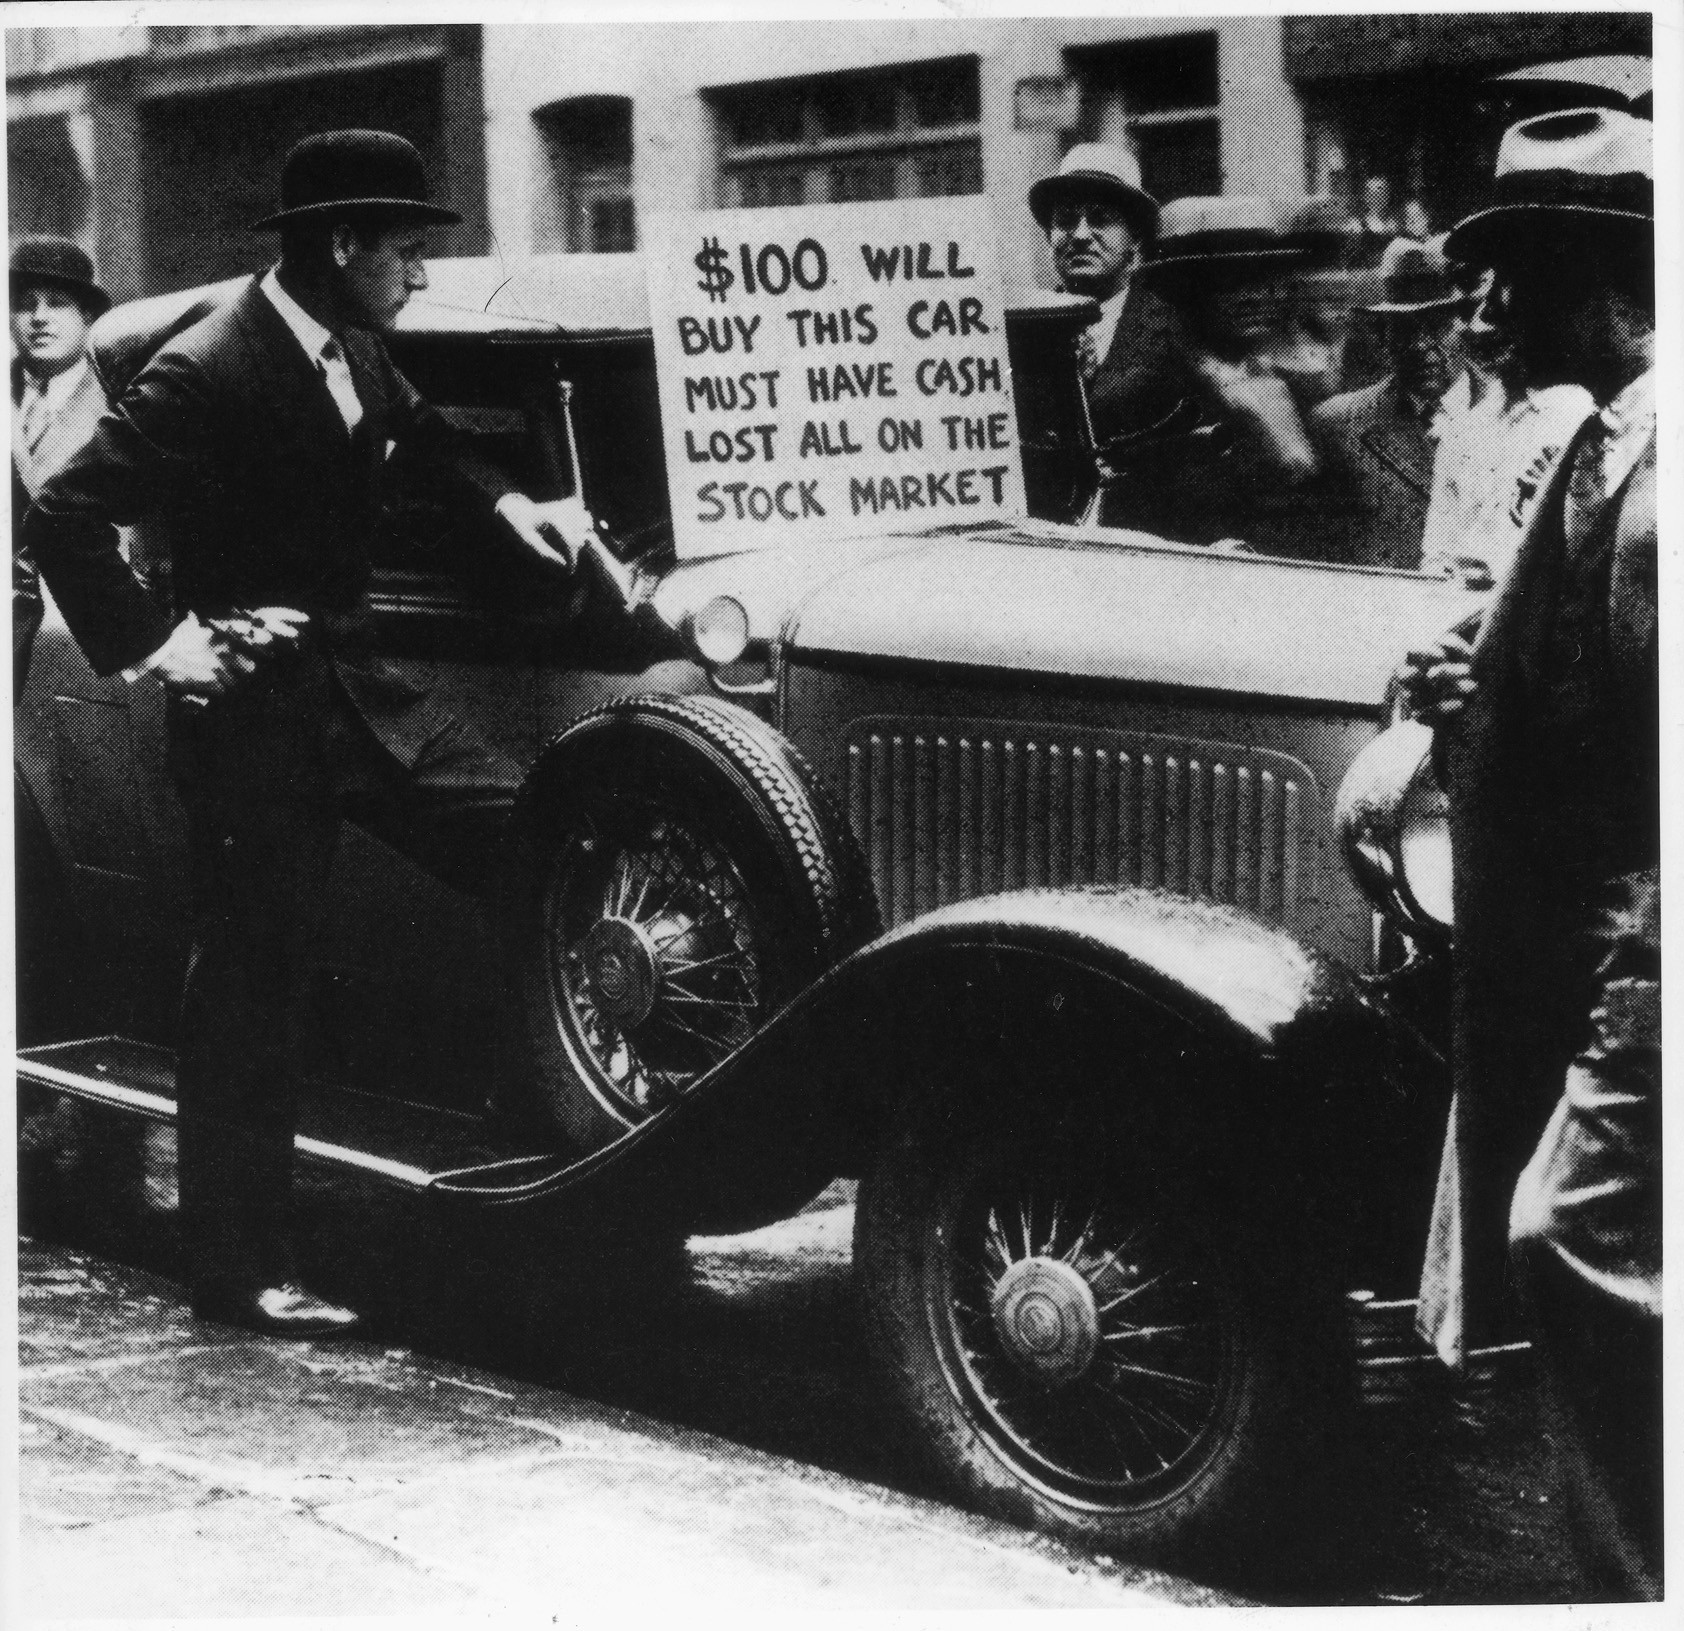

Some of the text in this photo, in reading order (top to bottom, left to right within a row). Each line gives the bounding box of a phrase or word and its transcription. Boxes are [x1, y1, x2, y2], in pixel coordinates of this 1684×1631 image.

[860, 241, 976, 283] WILL
[677, 315, 761, 356] BUY
[786, 303, 878, 348] THIS
[684, 370, 780, 413] MUST
[806, 362, 897, 403] HAVE
[684, 411, 1011, 463] LOST ALL ON THE
[697, 465, 1010, 522] STOCK MARKET
